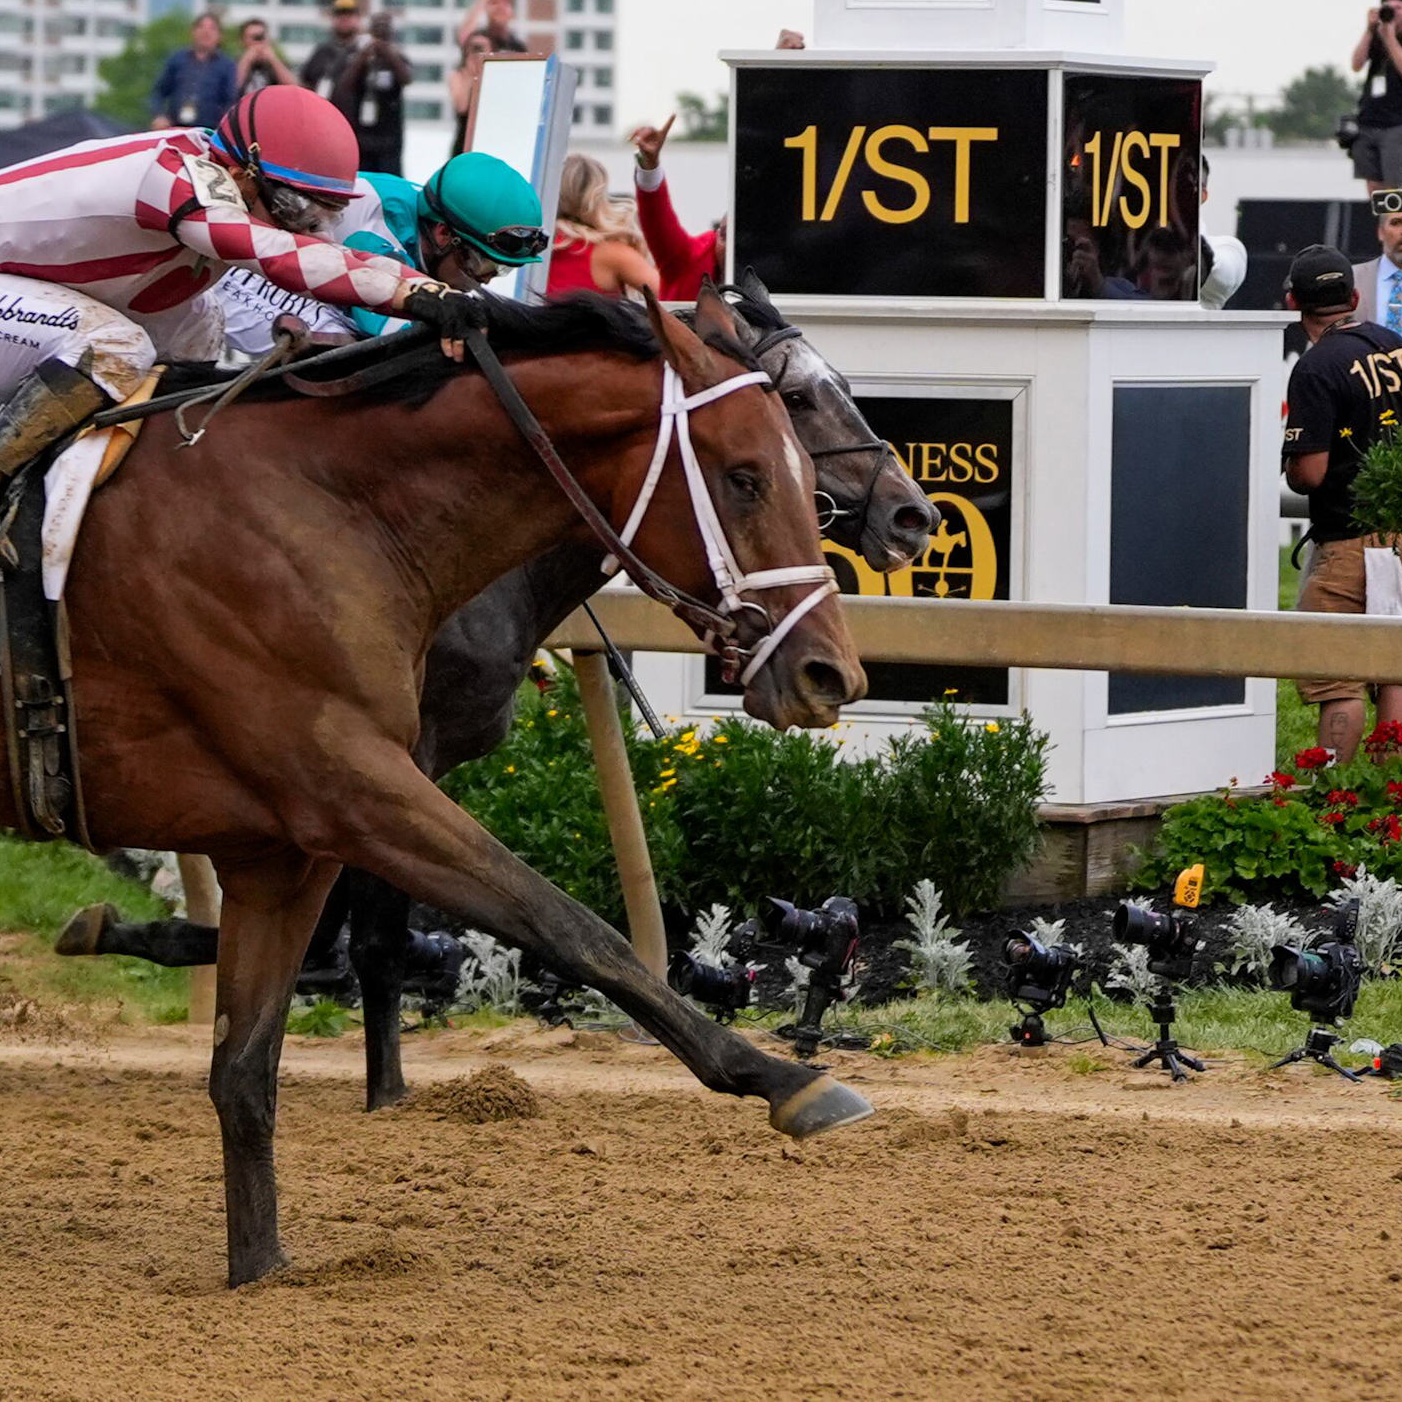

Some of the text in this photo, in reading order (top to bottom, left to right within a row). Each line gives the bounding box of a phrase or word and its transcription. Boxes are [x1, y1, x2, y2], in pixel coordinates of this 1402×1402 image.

[195, 159, 238, 204] 2
[784, 125, 998, 224] 1/ST
[1084, 130, 1181, 230] 1/ST
[222, 280, 275, 322] EAKHO
[888, 442, 999, 484] NESS
